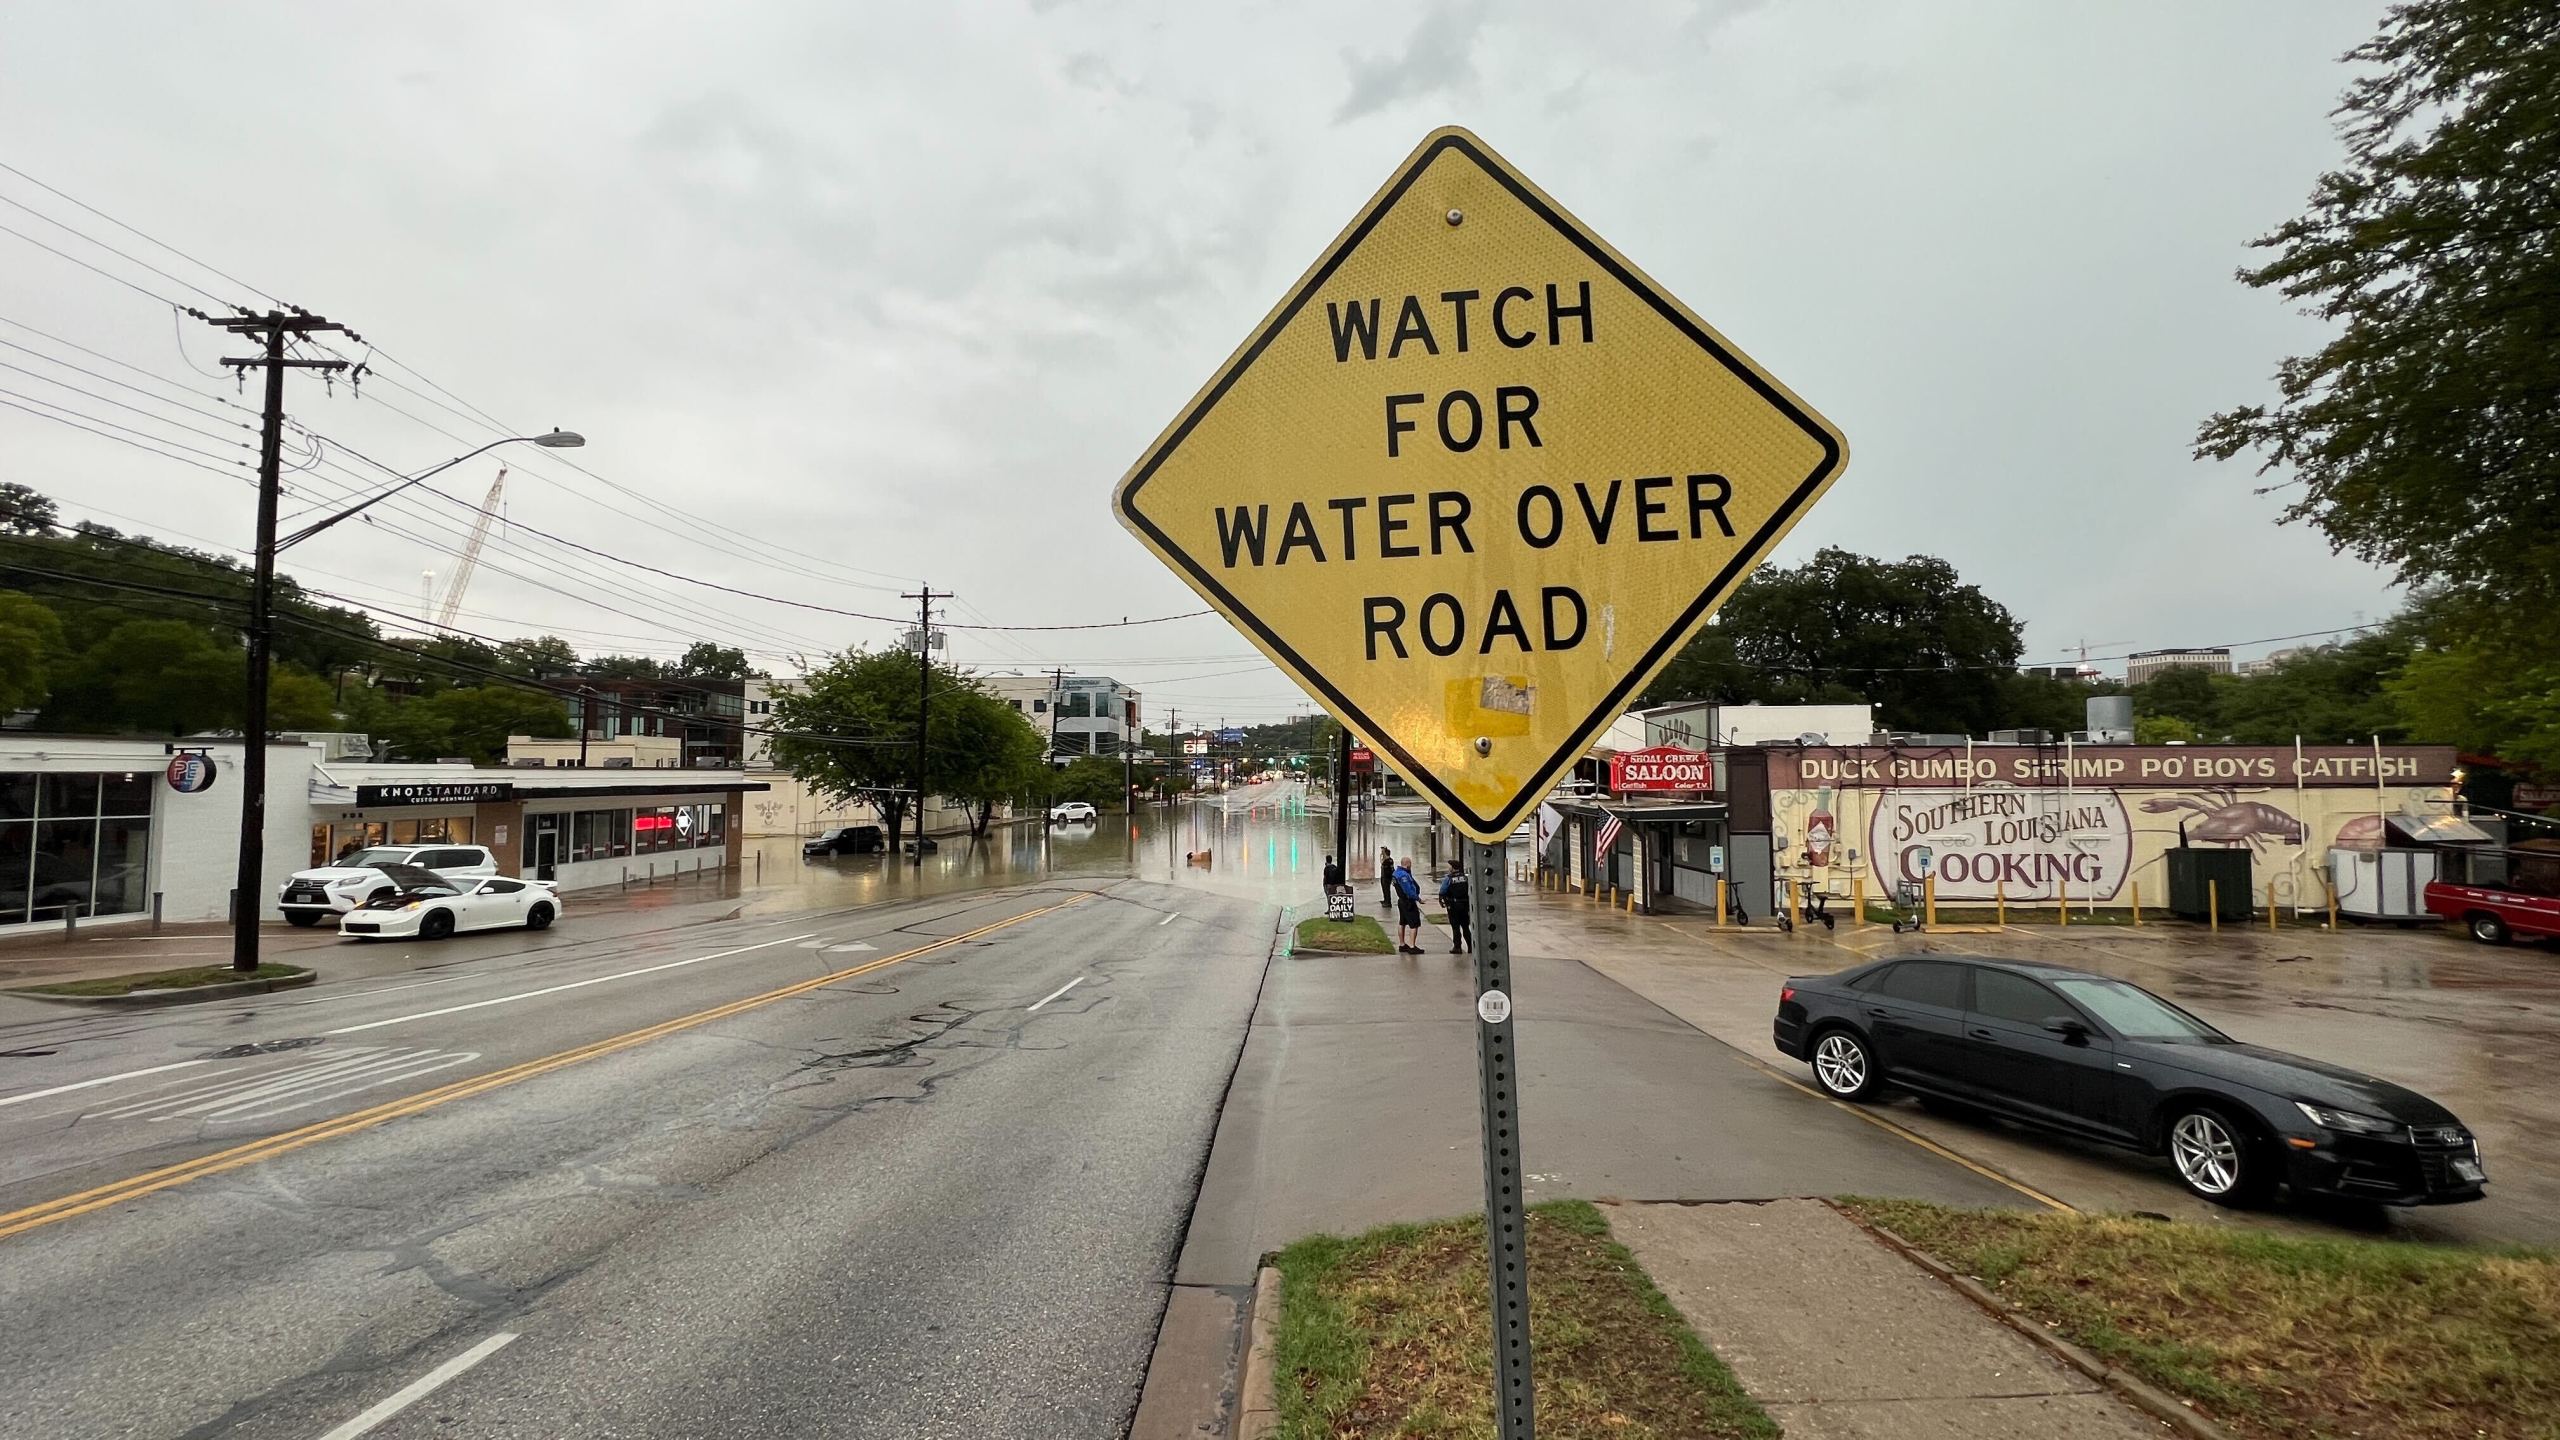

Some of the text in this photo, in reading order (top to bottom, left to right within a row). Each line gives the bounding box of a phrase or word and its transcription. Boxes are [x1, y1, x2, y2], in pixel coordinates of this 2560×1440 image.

[1326, 281, 1594, 363] WATCH
[1386, 386, 1543, 458] FOR
[1215, 473, 1736, 569] WATER OVER
[1364, 587, 1588, 661] ROAD
[173, 760, 201, 780] PE
[1625, 764, 1705, 781] SALOON
[1630, 753, 1700, 764] SHOAL CREEK
[1801, 758, 1881, 780] DUCK
[1889, 758, 1998, 780] GUMBO
[2013, 758, 2126, 779] SHRIMP
[2193, 757, 2277, 778] BOYS
[2292, 757, 2419, 777] CATFISH
[1893, 793, 2026, 842] SOUTHERN
[1984, 806, 2108, 846] LOUISIANA
[1900, 844, 2103, 889] COOKING
[1330, 896, 1353, 904] OPEN
